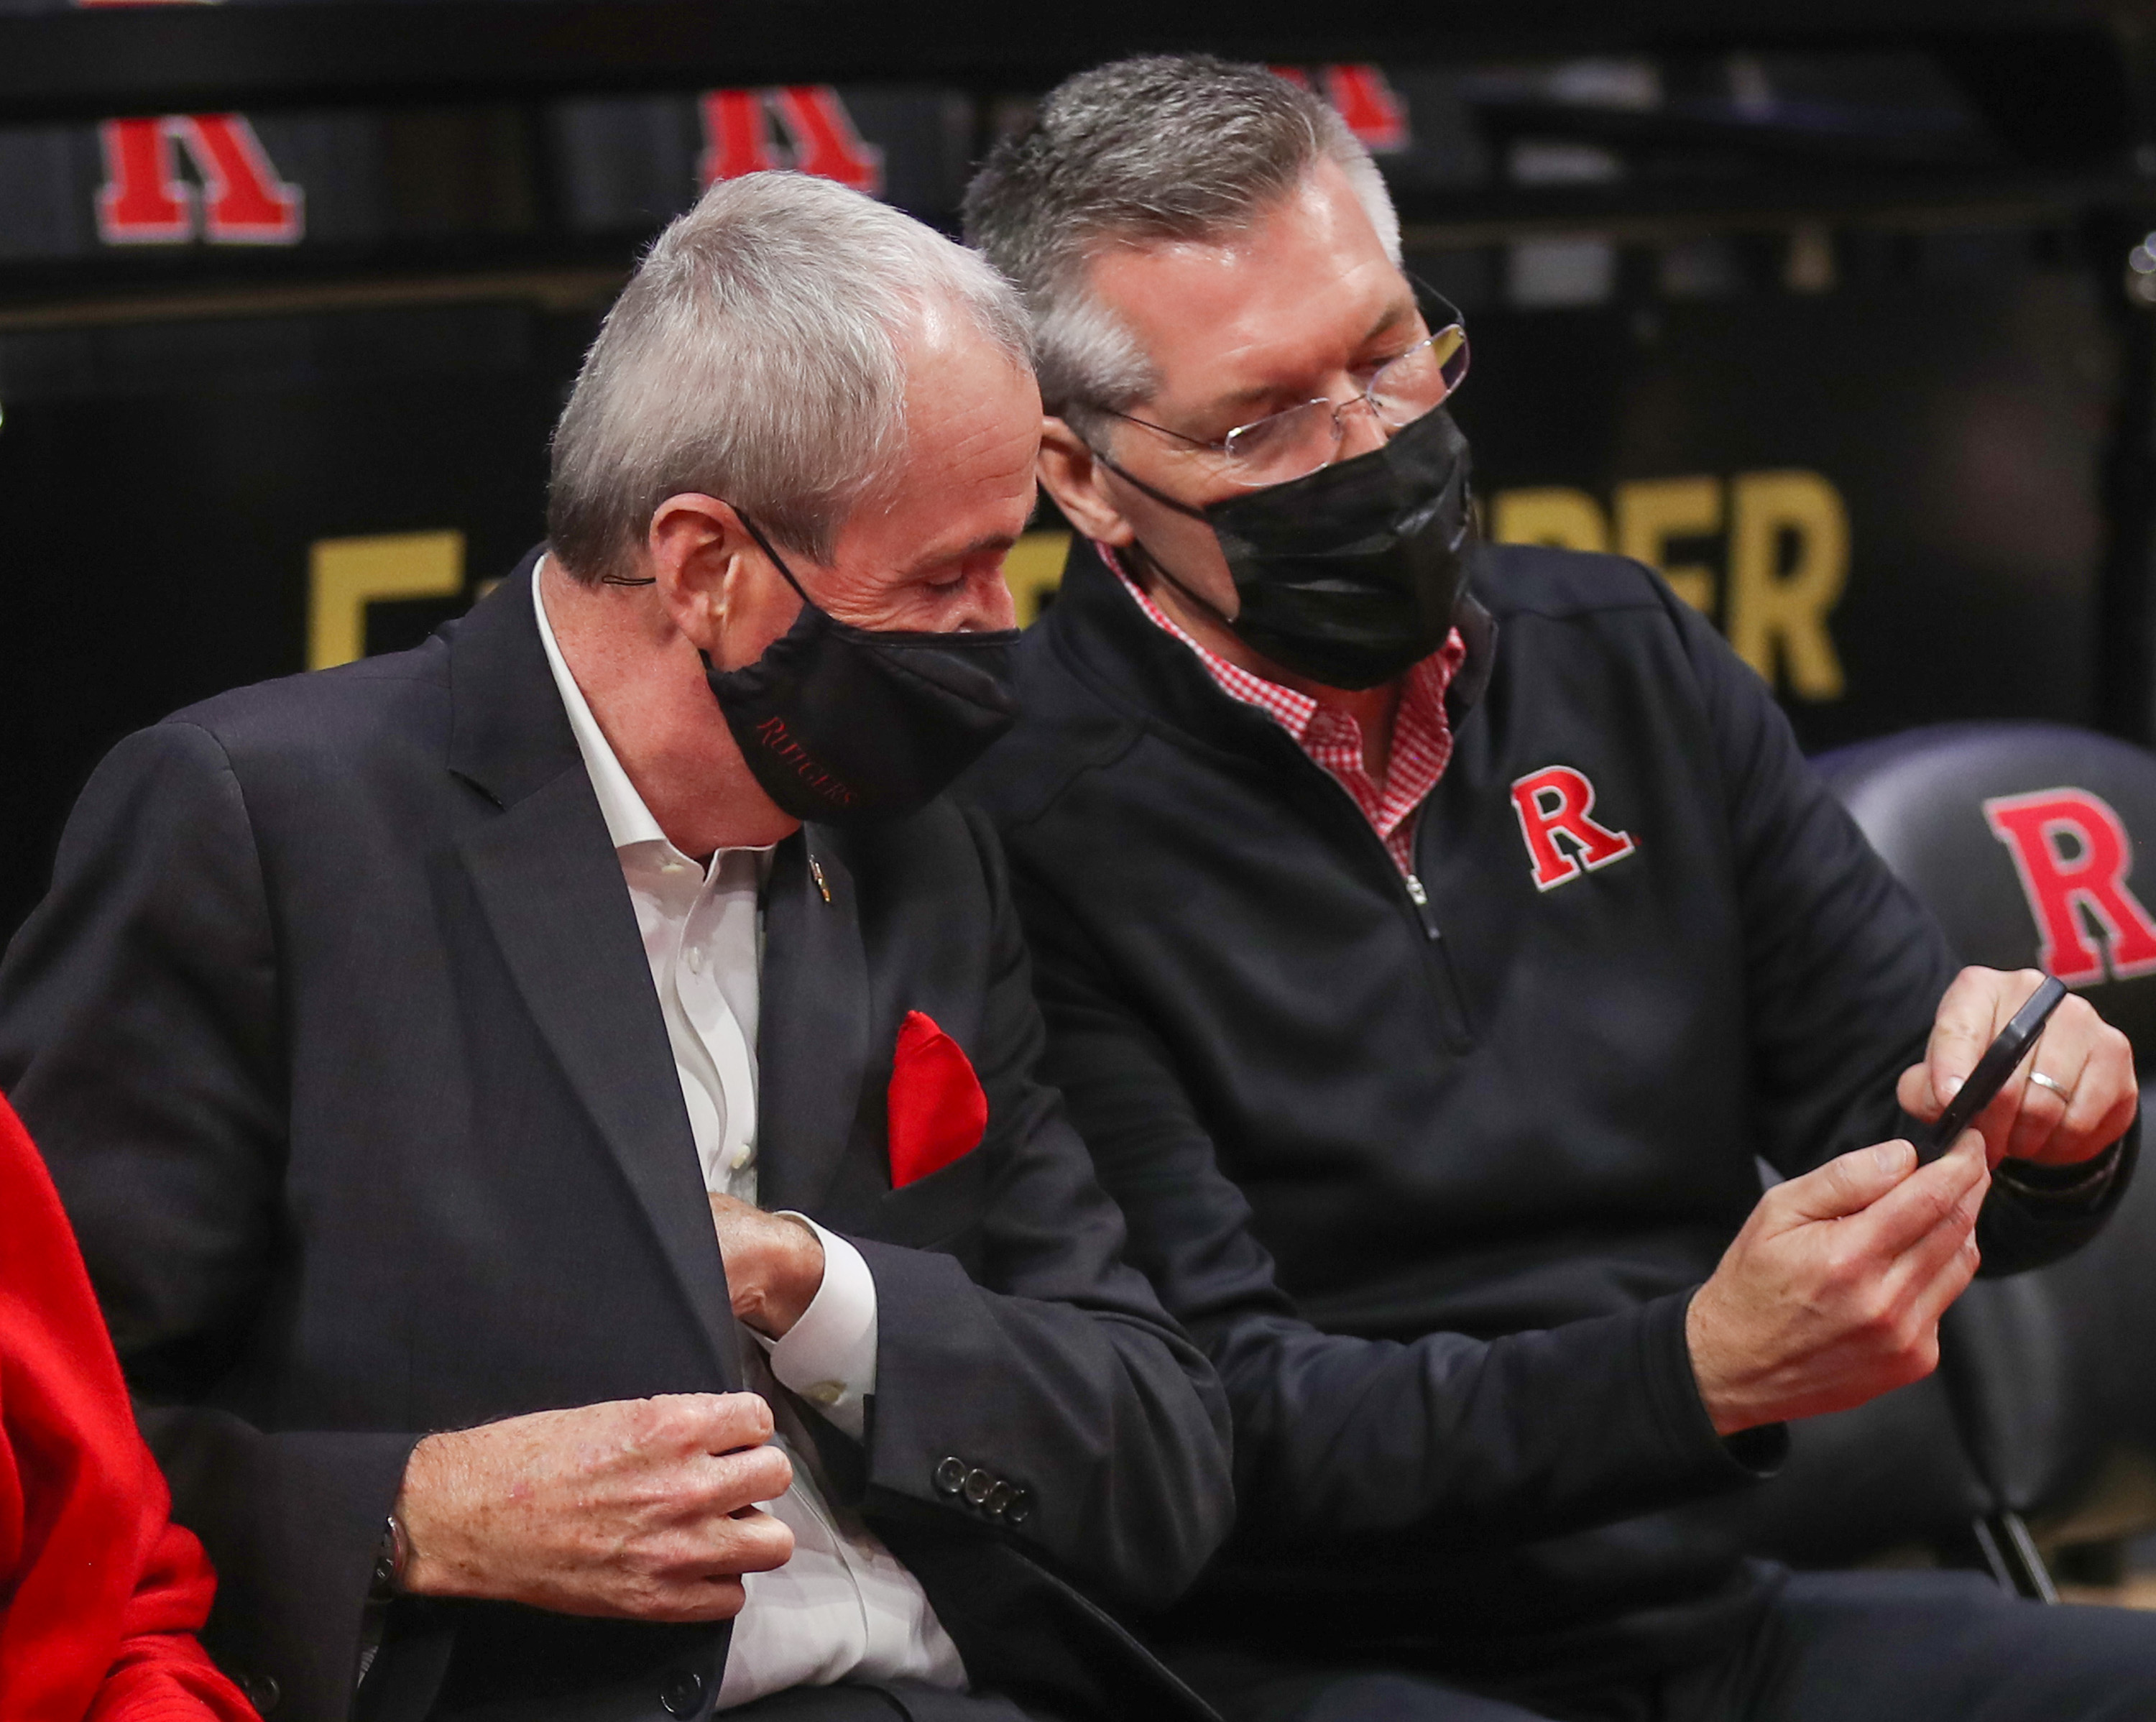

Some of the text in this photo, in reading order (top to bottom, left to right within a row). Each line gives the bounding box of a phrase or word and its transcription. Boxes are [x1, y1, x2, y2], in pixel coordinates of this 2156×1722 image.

[756, 717, 857, 806] RUTGERS
[1511, 765, 1636, 893] R
[1982, 788, 2156, 987] R
